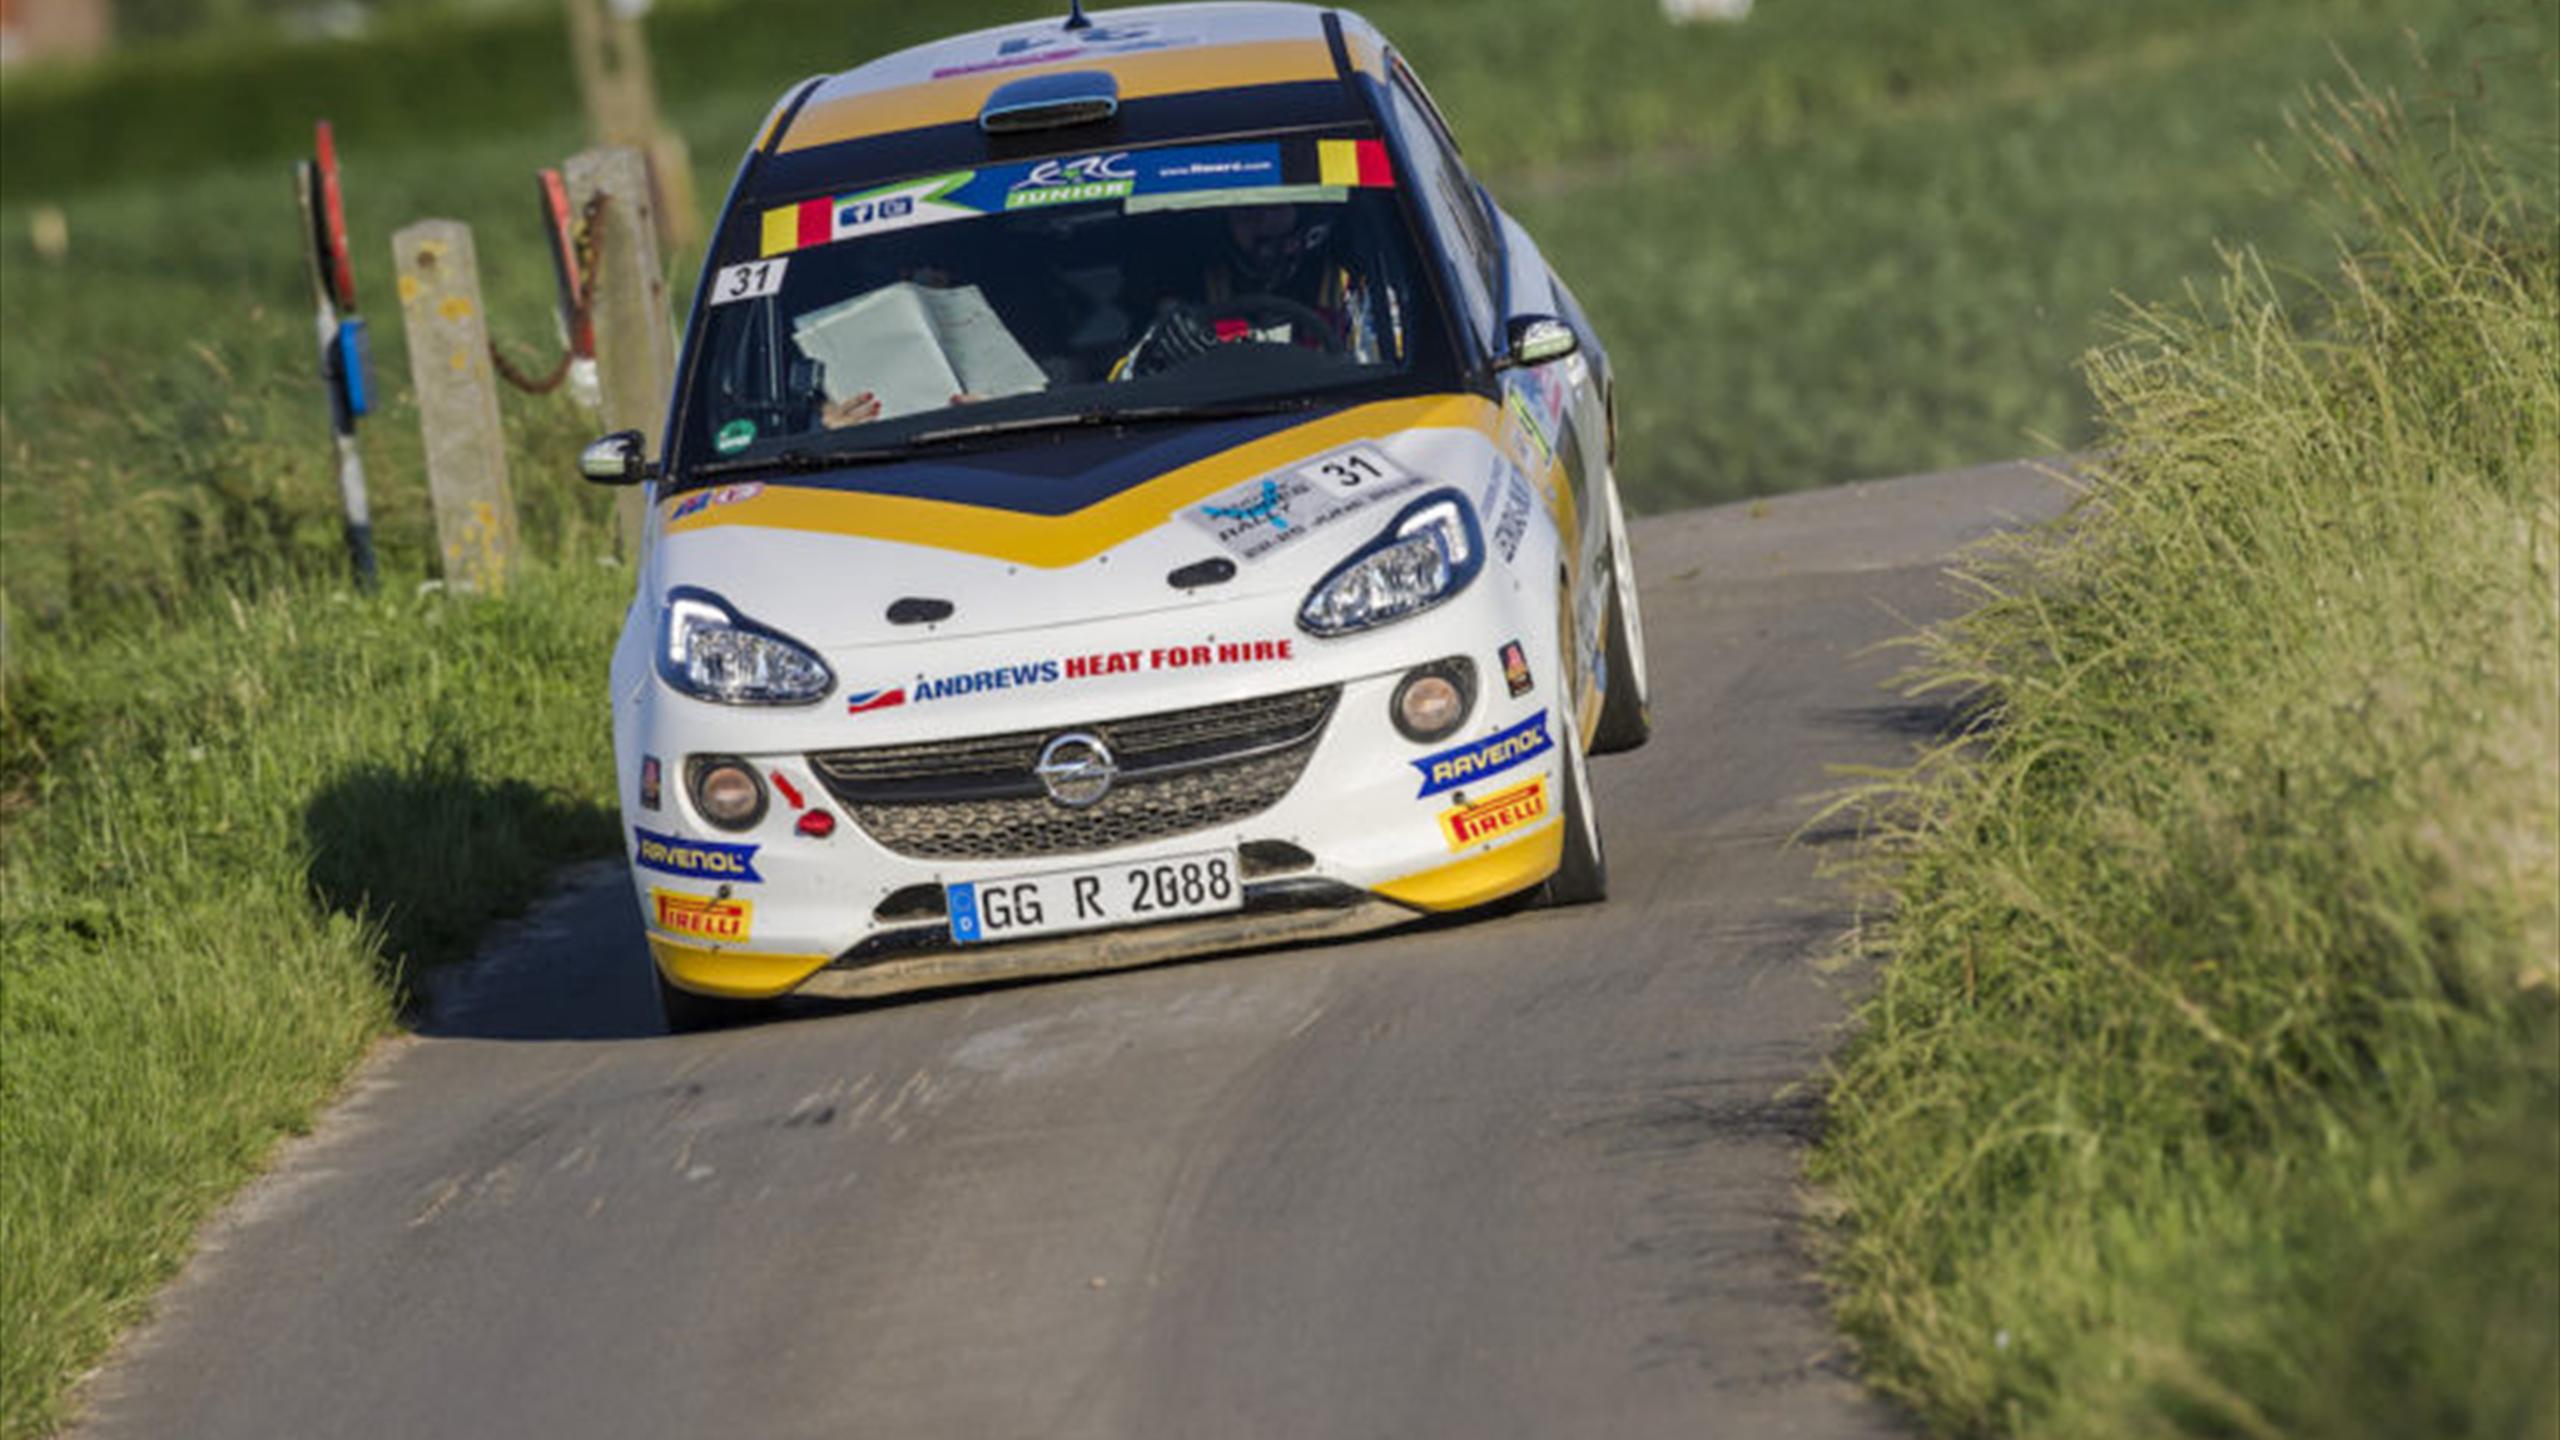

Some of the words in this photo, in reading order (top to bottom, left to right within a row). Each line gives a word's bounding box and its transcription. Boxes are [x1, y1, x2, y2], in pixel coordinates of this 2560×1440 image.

[1016, 183, 1126, 205] JUNIOR
[730, 264, 771, 296] 31
[1322, 455, 1383, 487] 31
[913, 659, 1059, 702] ANDREWS
[1065, 650, 1142, 679] HEAT
[1150, 644, 1212, 670] FOR
[1218, 639, 1293, 663] HIRE
[1431, 727, 1544, 783] RAVENOL
[1450, 783, 1544, 844] PIRELLI
[641, 839, 744, 873] RAVENOL
[656, 894, 744, 936] PIRELLI
[981, 883, 1044, 930] GG
[1073, 876, 1104, 919] R
[1128, 858, 1232, 912] 2088
